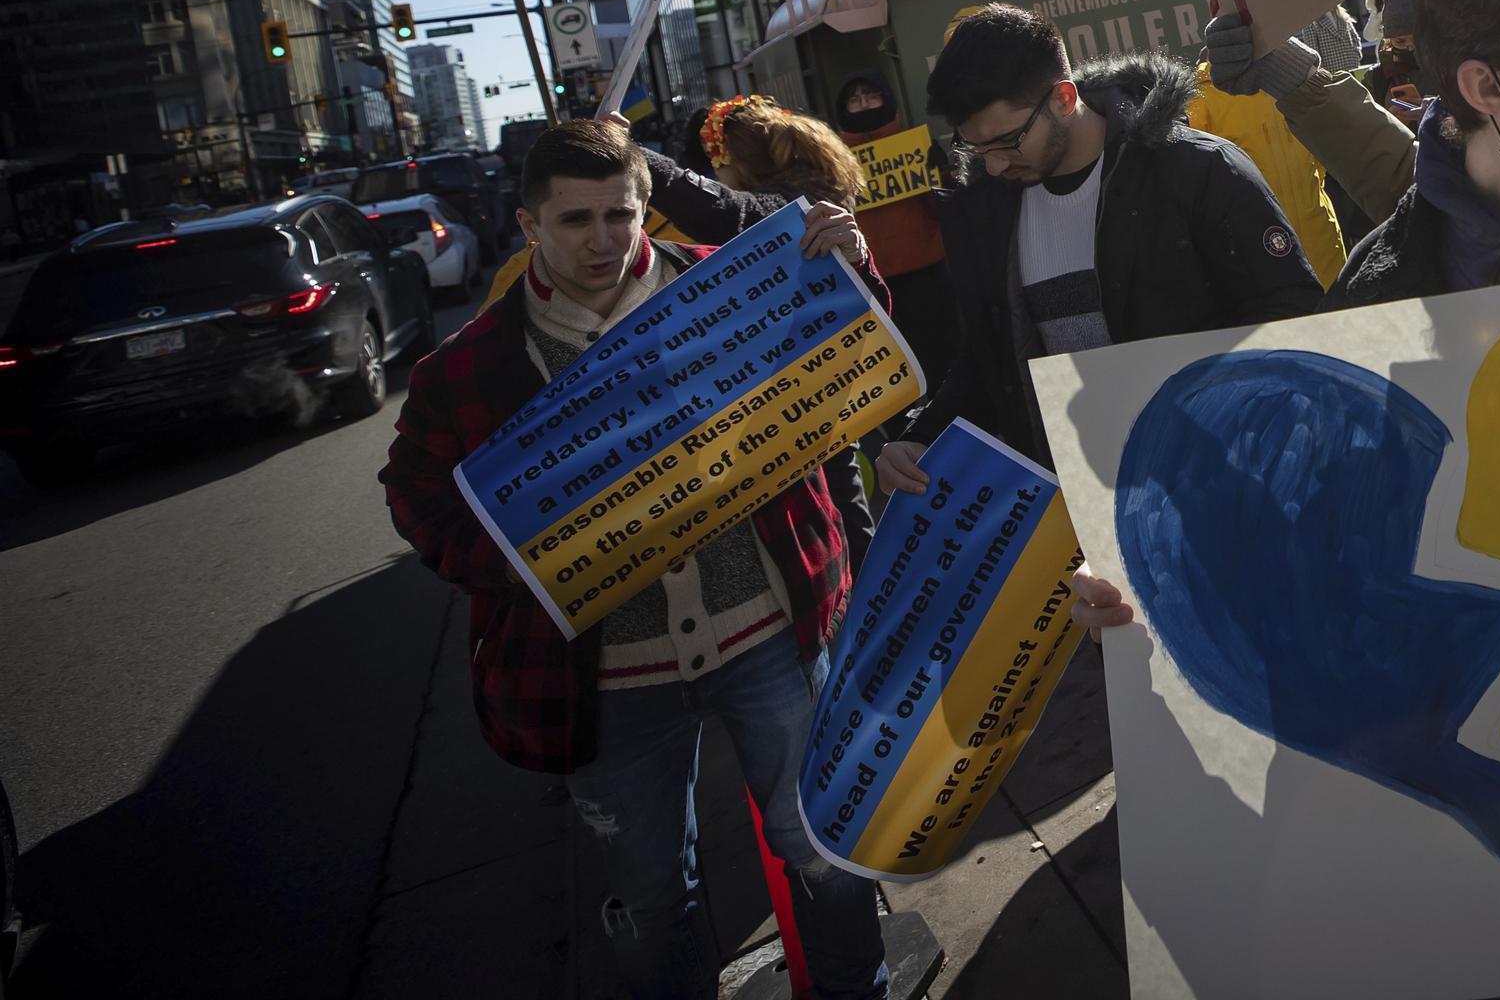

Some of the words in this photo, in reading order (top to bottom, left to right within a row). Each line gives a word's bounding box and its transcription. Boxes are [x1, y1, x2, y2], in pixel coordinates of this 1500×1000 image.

[853, 145, 876, 165] ET
[868, 148, 925, 178] HANDS
[494, 406, 635, 504] predatory.
[636, 383, 663, 406] It
[665, 351, 717, 388] was
[722, 290, 807, 353] started
[807, 272, 837, 297] by
[517, 368, 631, 449] brothers
[632, 349, 660, 371] is
[664, 296, 742, 351] unjust
[745, 265, 790, 301] and
[537, 496, 558, 514] a
[562, 448, 623, 497] mad
[626, 394, 714, 453] tyrant,
[714, 360, 757, 395] but
[760, 337, 797, 365] we
[801, 310, 837, 339] are
[544, 361, 590, 400] war
[597, 337, 629, 361] on
[634, 303, 673, 336] our
[676, 230, 793, 304] Ukrainian
[527, 454, 679, 561] reasonable
[681, 375, 800, 456] Russians,
[800, 347, 837, 373] we
[840, 318, 877, 350] are
[556, 553, 592, 583] on
[595, 518, 643, 555] the
[648, 477, 703, 520] side
[708, 450, 735, 477] of
[738, 422, 780, 456] the
[781, 346, 892, 424] Ukrainian
[565, 545, 666, 617] people,
[669, 508, 709, 539] we
[715, 476, 755, 509] are
[761, 451, 791, 476] on
[794, 420, 833, 451] the
[838, 386, 884, 422] side
[888, 362, 909, 386] of
[667, 492, 769, 568] common
[777, 432, 848, 489] sense!
[817, 709, 864, 793] these
[861, 576, 941, 704] madmen
[937, 538, 962, 571] at
[955, 486, 994, 533] the
[824, 762, 878, 844] head
[874, 721, 899, 759] of
[896, 666, 932, 719] our
[929, 484, 1041, 665] government.
[832, 652, 855, 703] are
[855, 513, 931, 648] ashamed
[930, 477, 954, 511] of
[897, 814, 938, 859] We
[936, 757, 970, 806] are
[968, 639, 1038, 748] against
[1034, 580, 1072, 633] any
[948, 802, 973, 830] in
[970, 747, 1002, 794] the
[1001, 675, 1042, 739] 21st
